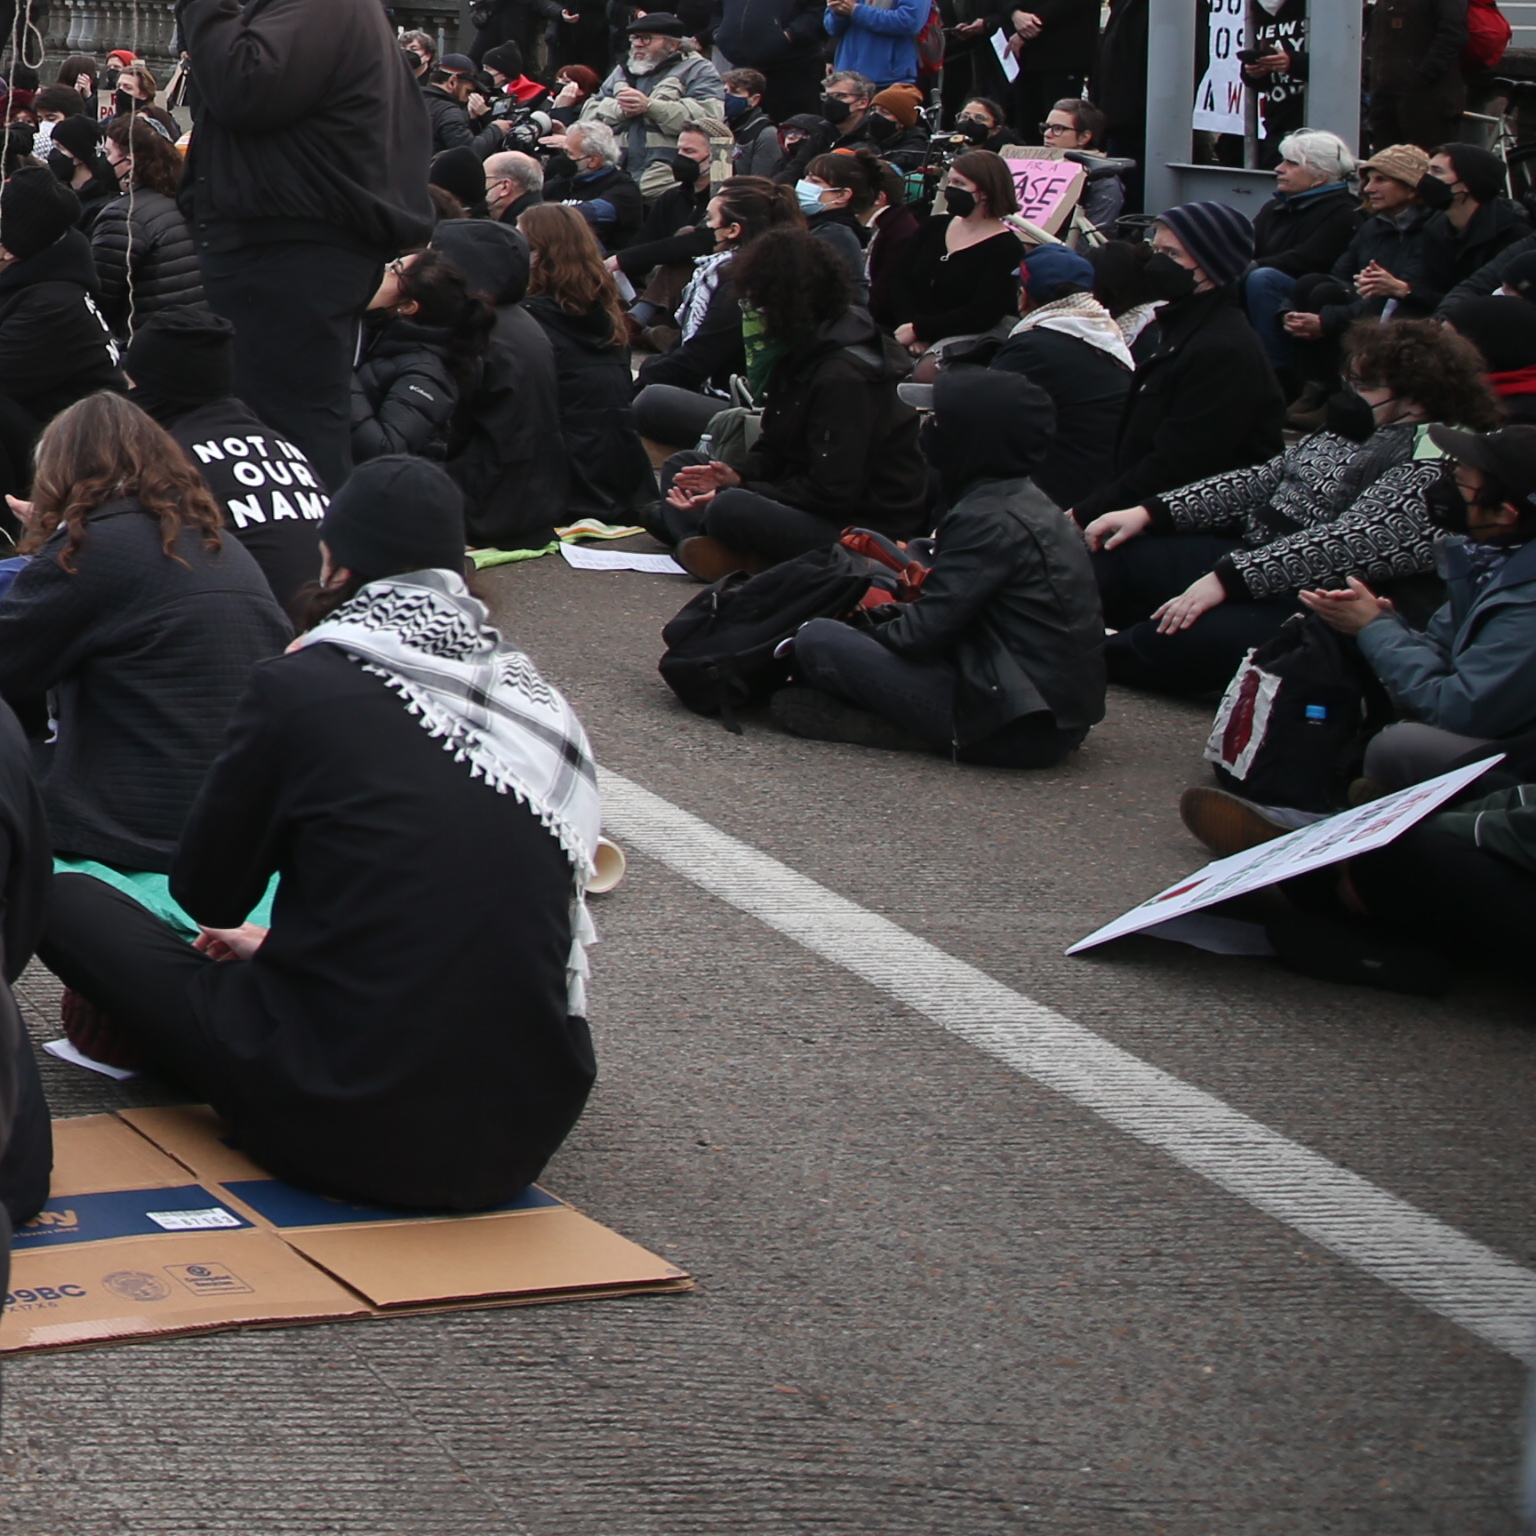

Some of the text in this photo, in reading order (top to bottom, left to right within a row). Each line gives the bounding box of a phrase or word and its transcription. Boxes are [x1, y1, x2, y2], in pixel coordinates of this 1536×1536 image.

[1002, 149, 1059, 160] ANOTHER
[1049, 164, 1058, 172] A
[192, 435, 269, 465] NOT
[232, 460, 319, 488] OUR
[226, 490, 332, 530] NAM
